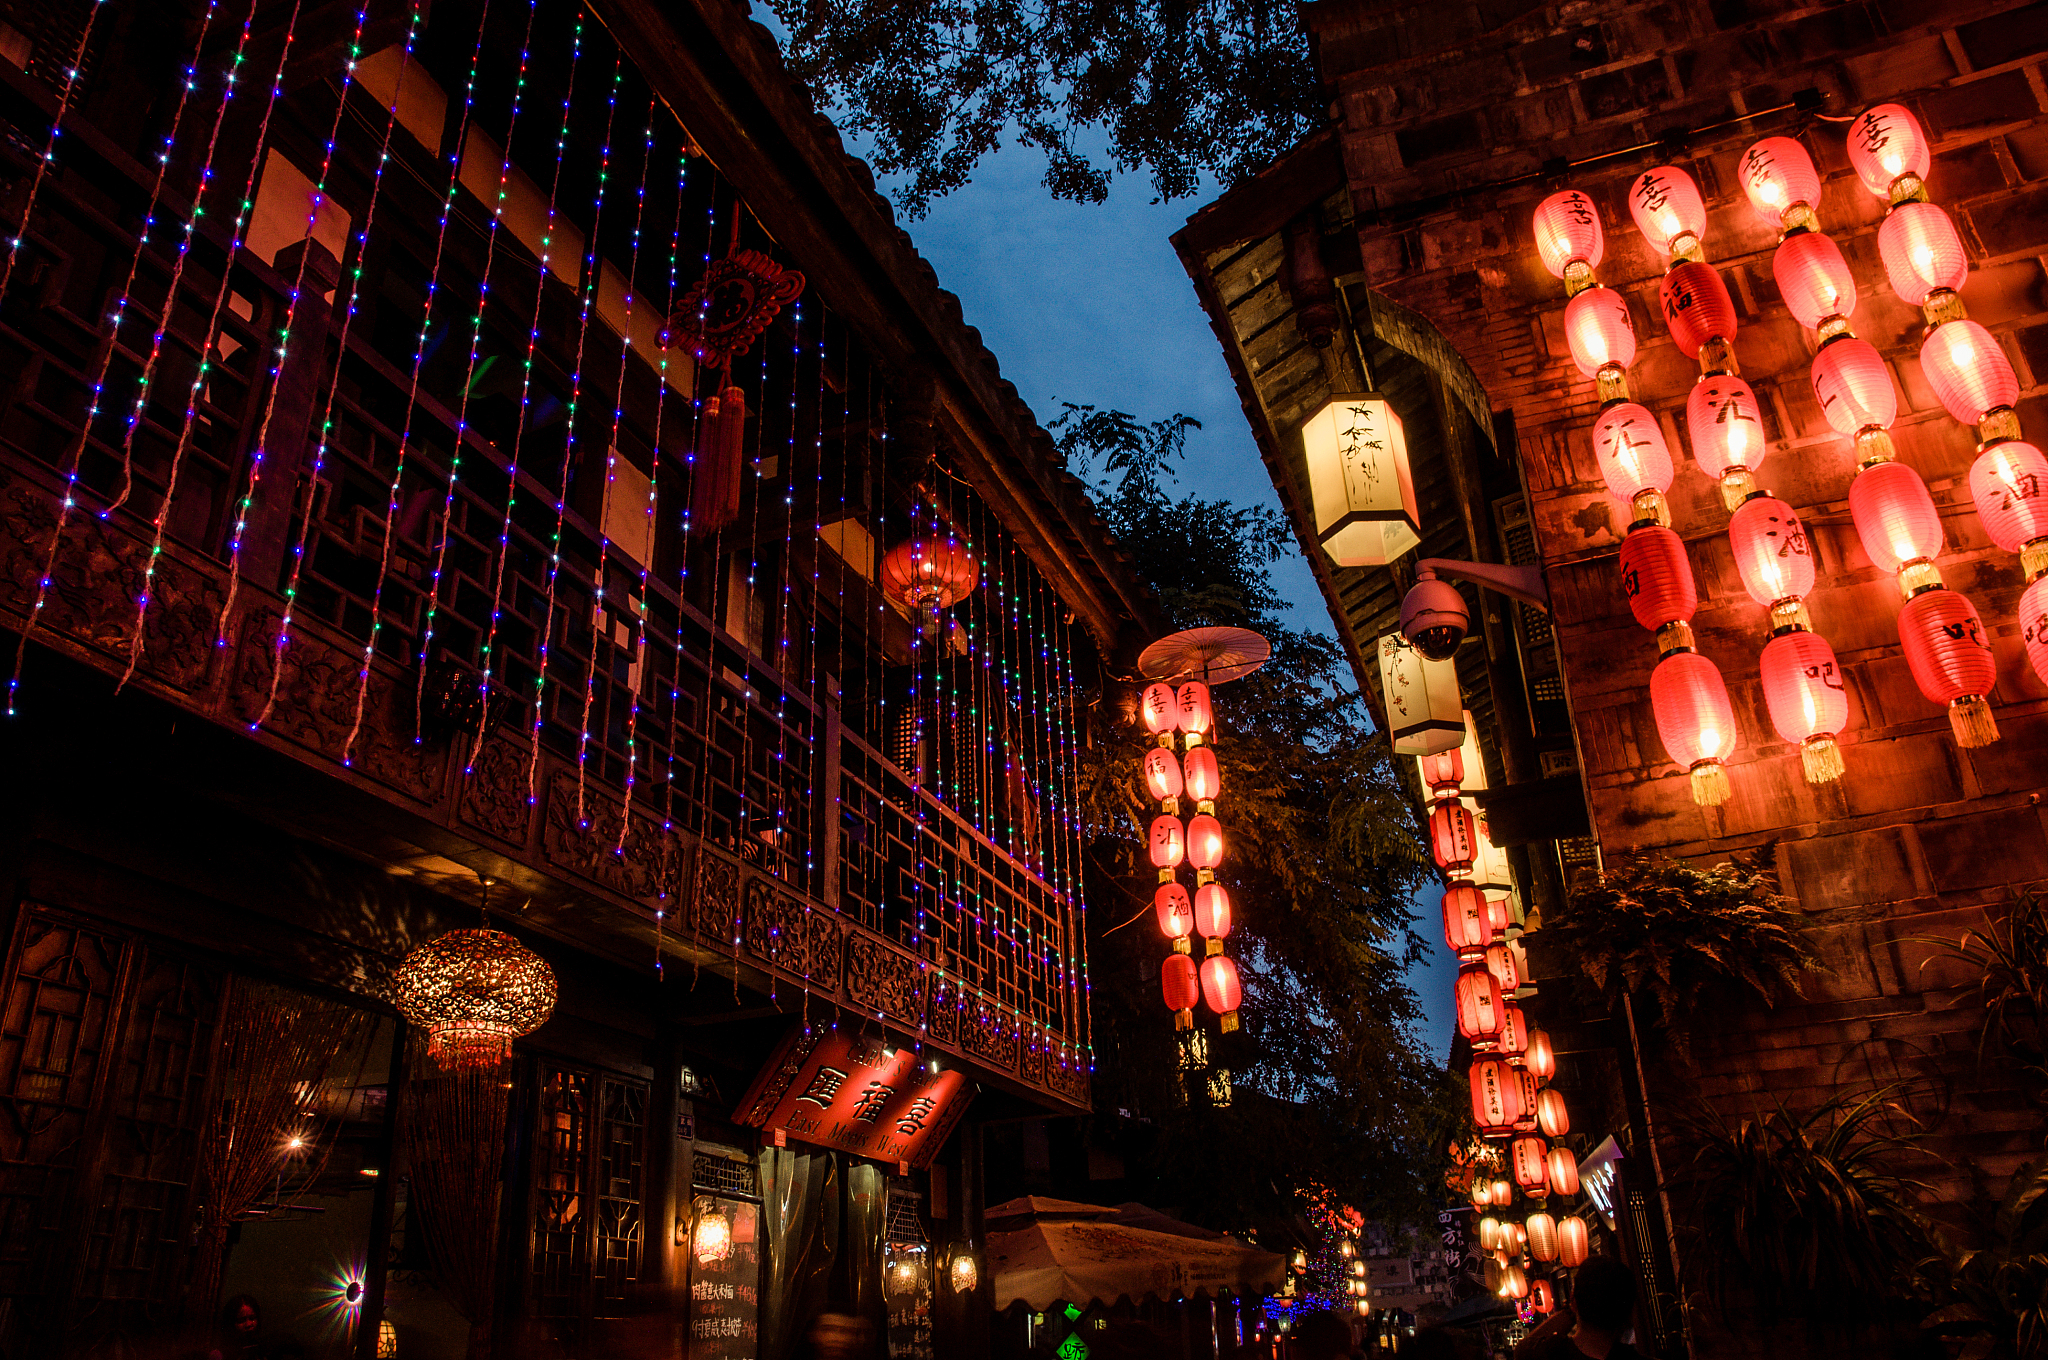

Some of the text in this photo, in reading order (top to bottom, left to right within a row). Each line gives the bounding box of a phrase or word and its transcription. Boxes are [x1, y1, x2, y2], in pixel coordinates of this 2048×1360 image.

[784, 1109, 908, 1158] East Meets West
